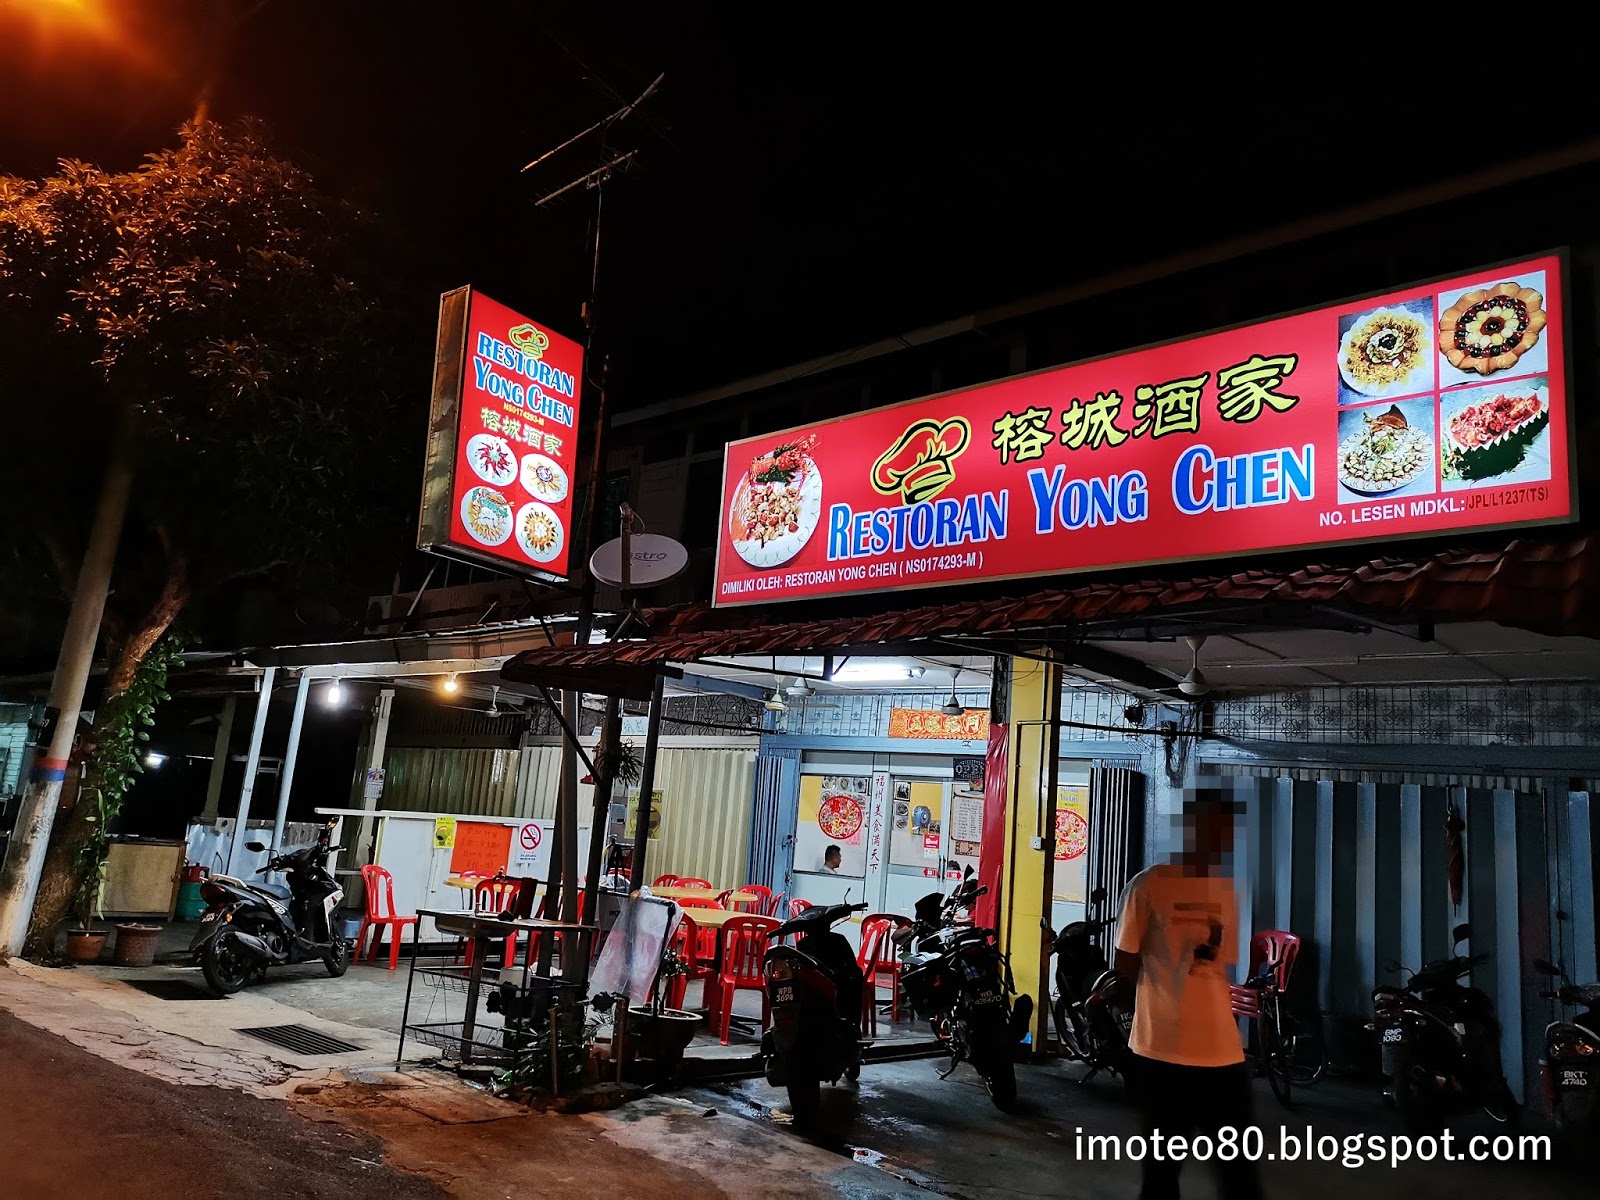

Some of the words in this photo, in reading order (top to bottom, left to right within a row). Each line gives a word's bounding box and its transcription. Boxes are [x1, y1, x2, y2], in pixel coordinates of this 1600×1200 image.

[473, 356, 524, 407] YONG
[526, 384, 574, 428] CHEN
[478, 331, 574, 398] RESTORAN
[480, 407, 563, 457] 榕城酒家
[992, 353, 1300, 465] 榕城酒家
[826, 488, 1009, 562] RESTORAN
[1027, 464, 1148, 534] YONG
[1172, 443, 1315, 515] CHEN
[1319, 510, 1347, 527] NO.
[1351, 504, 1405, 524] LESEN
[630, 551, 668, 560] stro
[722, 578, 755, 595] DIMILIKI
[756, 576, 783, 591] OLEH:
[785, 569, 835, 588] RESTORAN
[837, 565, 866, 582] YONG
[868, 561, 897, 578] CHEN
